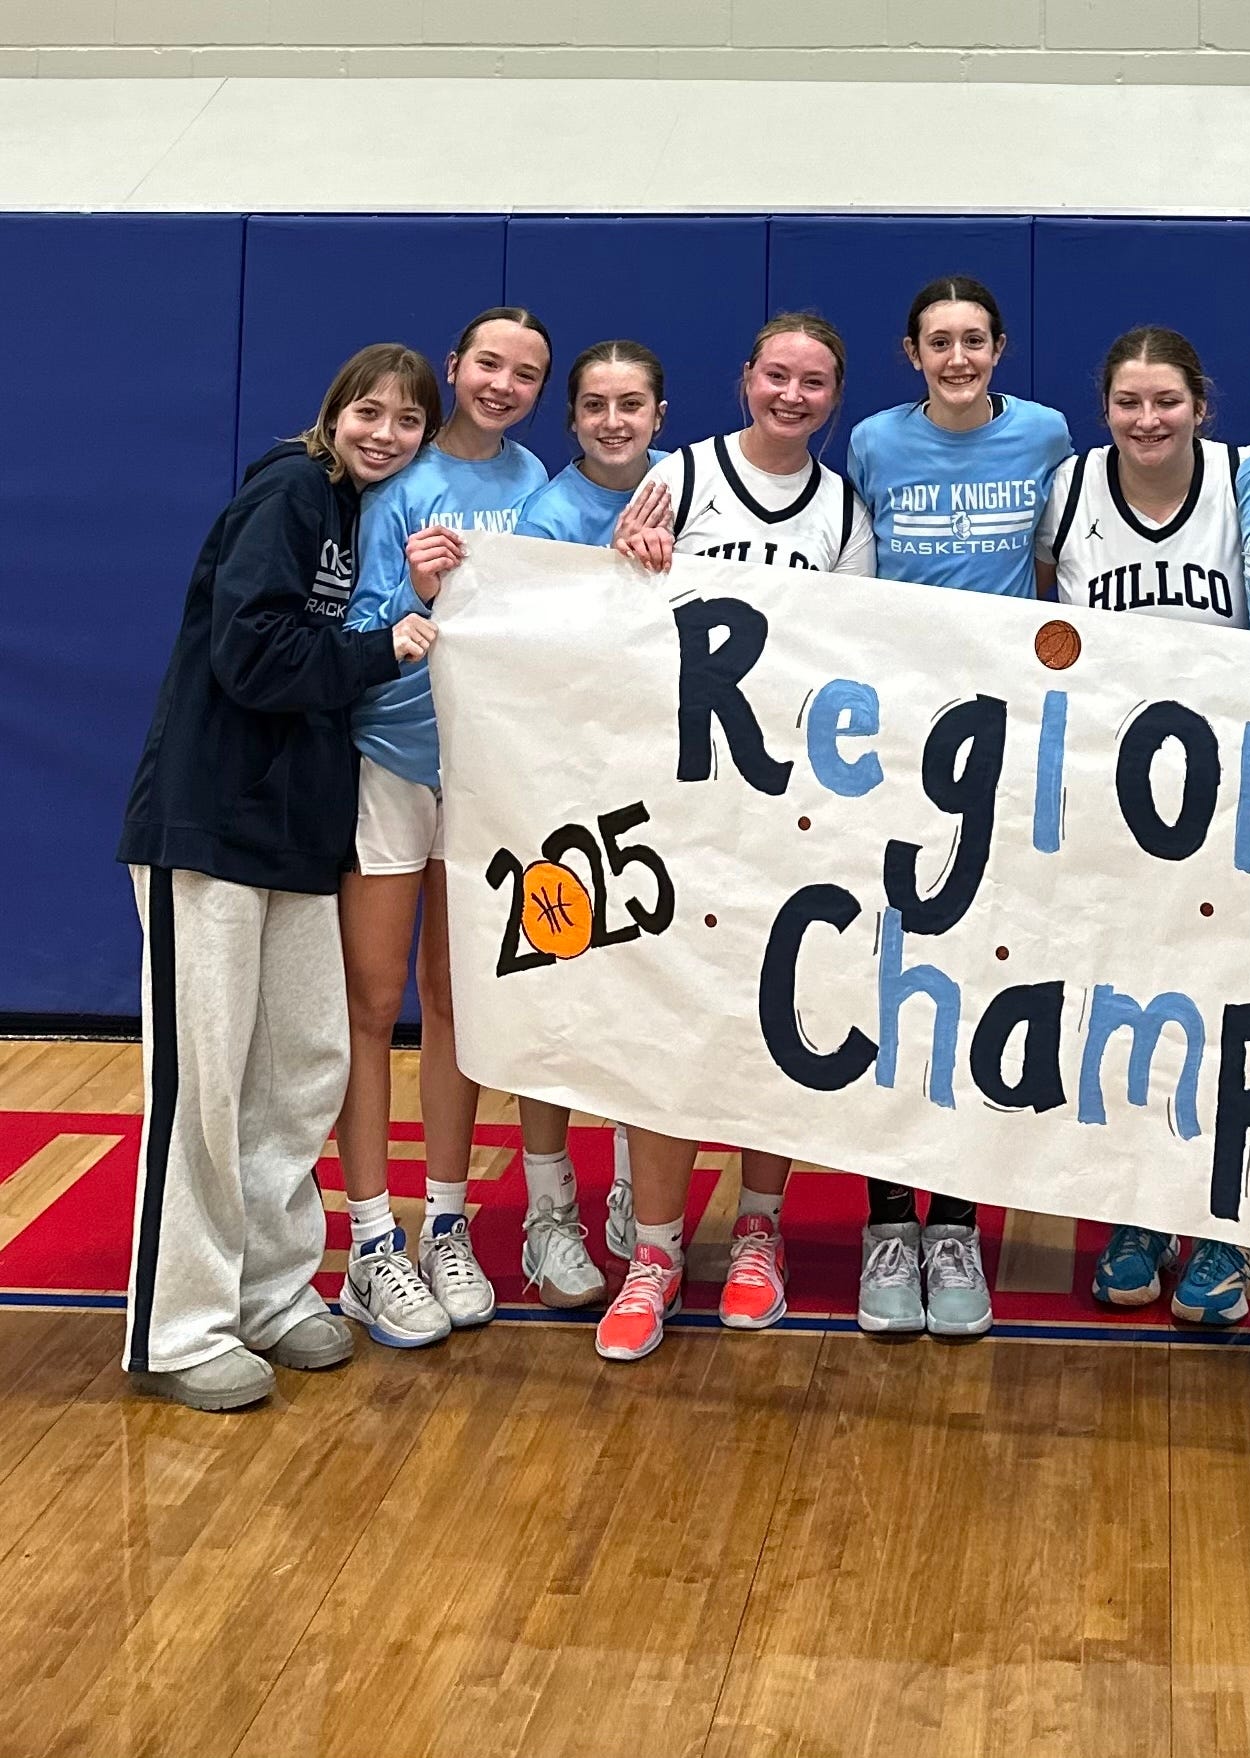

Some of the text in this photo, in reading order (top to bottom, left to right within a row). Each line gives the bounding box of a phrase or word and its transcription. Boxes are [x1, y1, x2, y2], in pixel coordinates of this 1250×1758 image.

[888, 480, 1036, 512] LADY KNIGHTS
[473, 508, 521, 534] KNIG
[891, 535, 1029, 555] BASKETBALL
[1088, 561, 1233, 618] HILLCO
[304, 598, 347, 619] RACK
[485, 800, 675, 978] 2025
